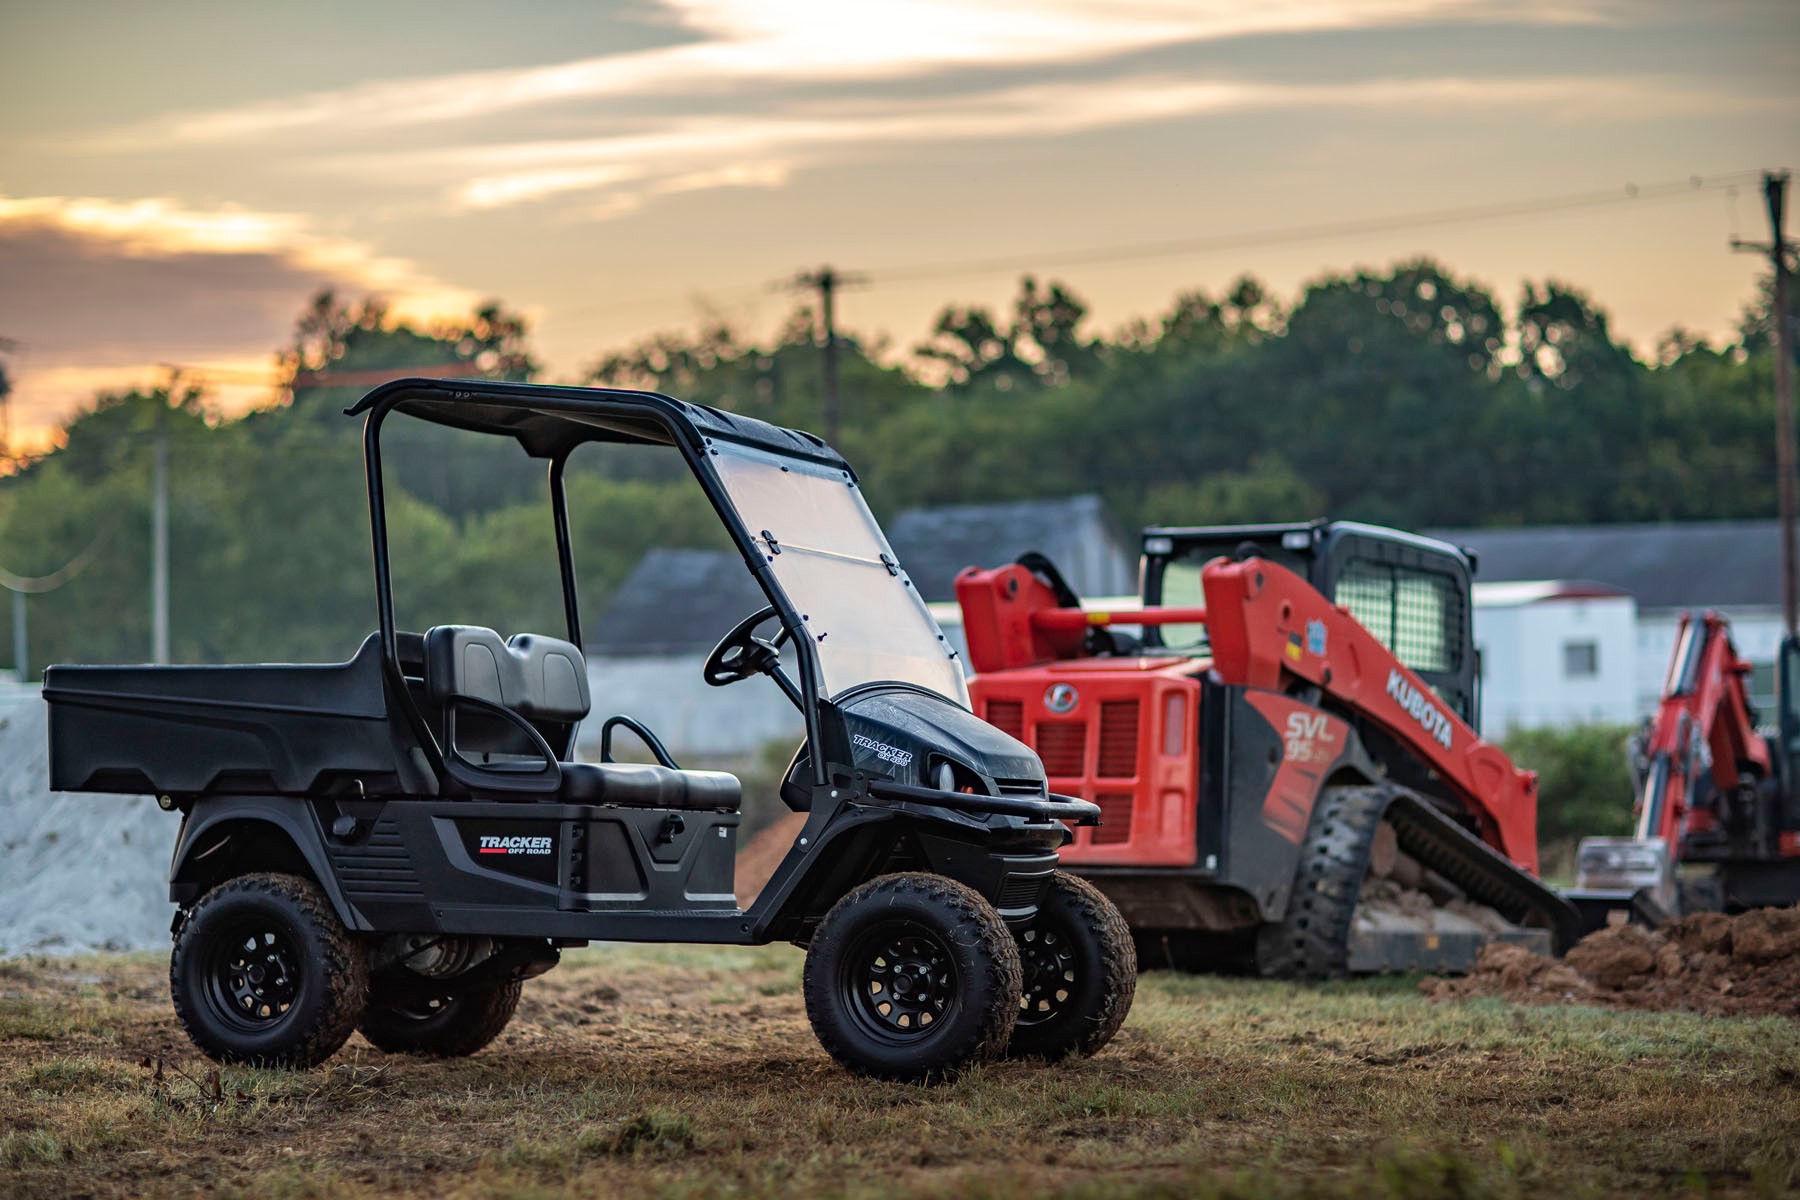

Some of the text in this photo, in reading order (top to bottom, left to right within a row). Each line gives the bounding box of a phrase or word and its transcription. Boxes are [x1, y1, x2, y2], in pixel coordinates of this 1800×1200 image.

[1387, 669, 1452, 751] KUBOTA
[1285, 712, 1335, 741] SVL
[853, 734, 912, 763] TRACKER
[480, 836, 552, 848] TRACKER
